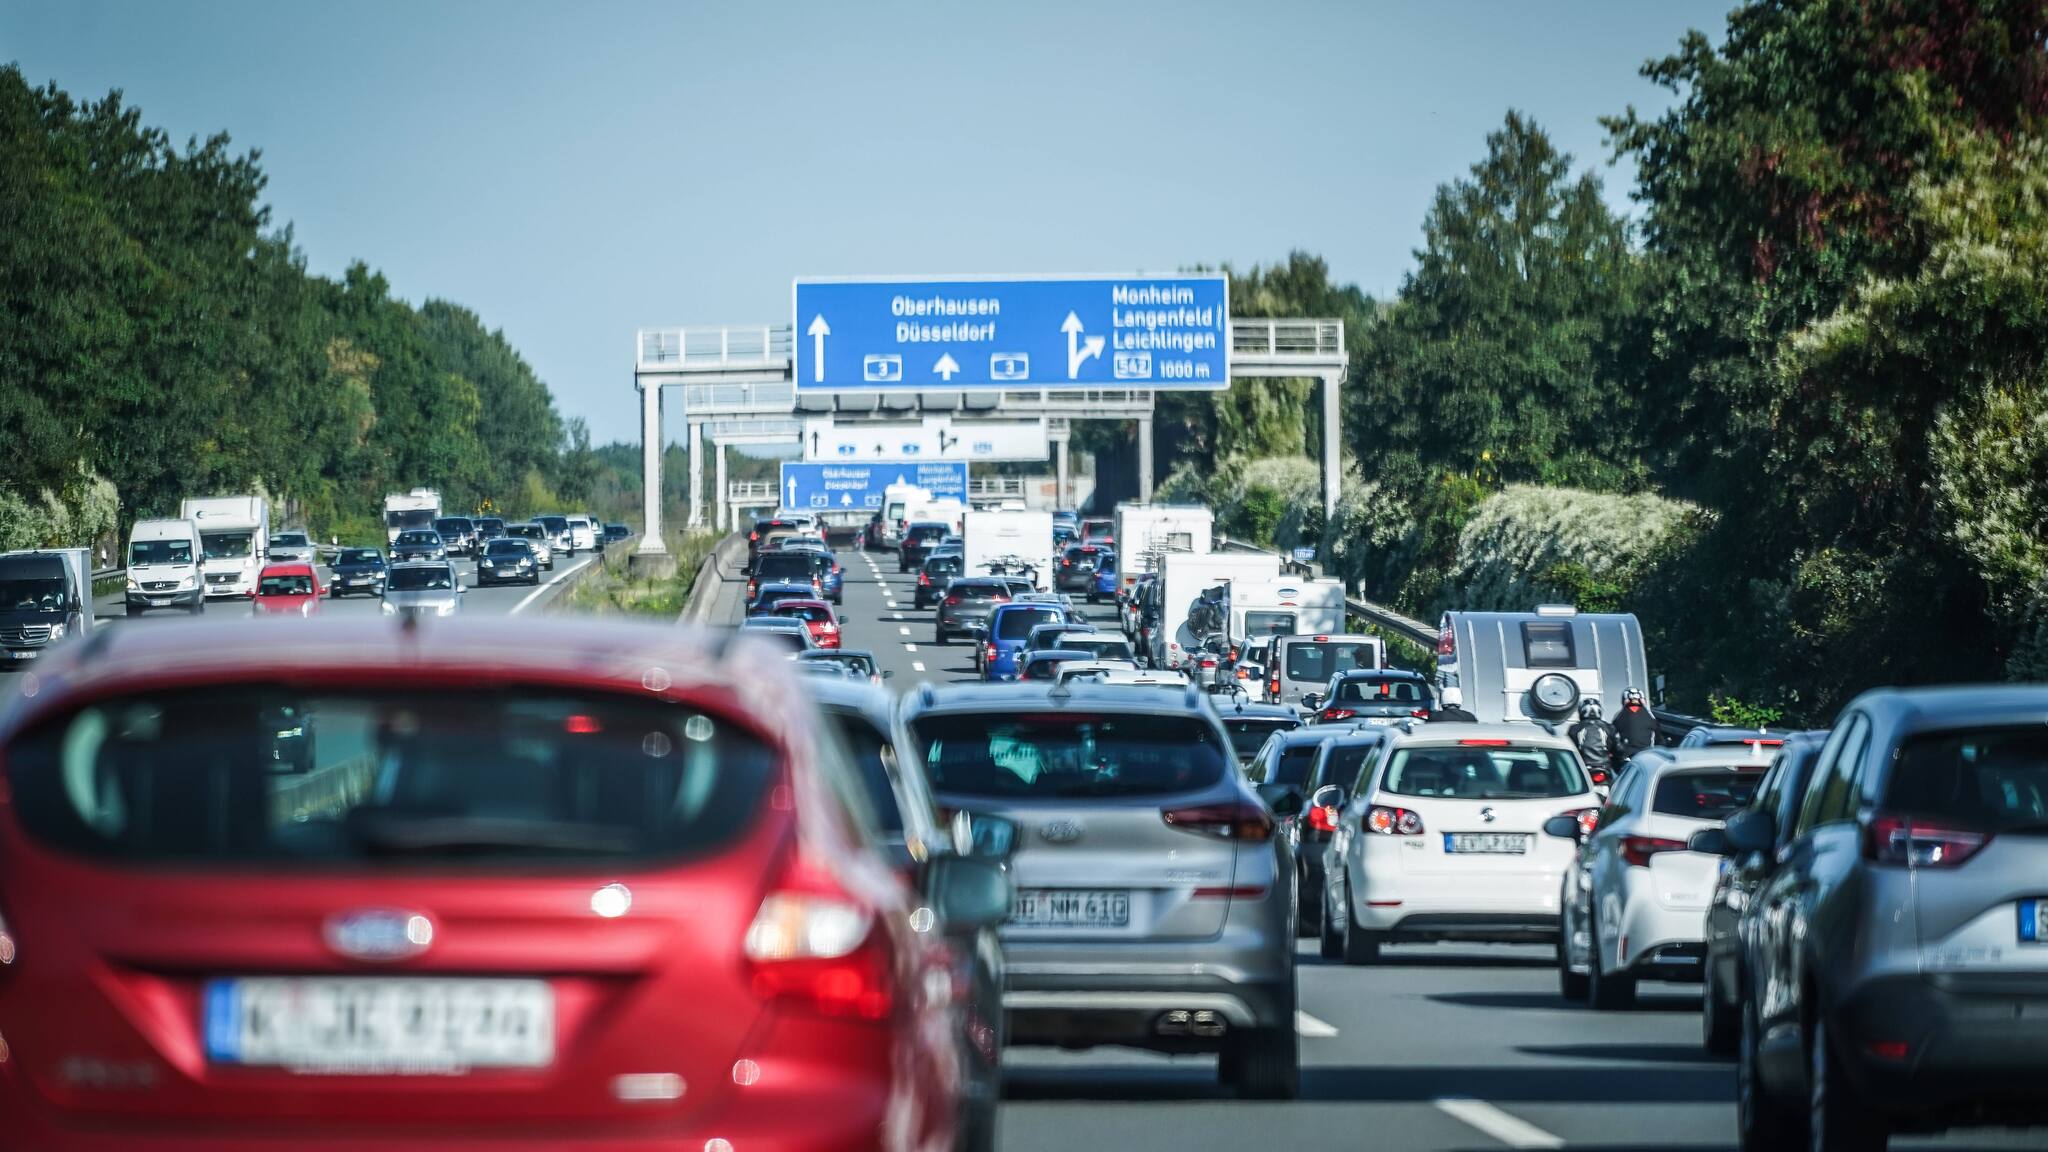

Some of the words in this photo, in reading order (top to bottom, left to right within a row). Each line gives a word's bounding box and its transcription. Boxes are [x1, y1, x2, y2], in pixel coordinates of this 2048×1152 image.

[1112, 284, 1194, 304] Monheim
[891, 295, 1000, 316] Oberhausen
[1112, 306, 1212, 330] Langenfeld
[896, 320, 995, 342] Düsseldorf
[1112, 328, 1215, 352] Leichlingen
[879, 360, 888, 377] 3
[1117, 358, 1147, 375] 542
[1160, 360, 1193, 378] 1000
[1195, 362, 1210, 378] m
